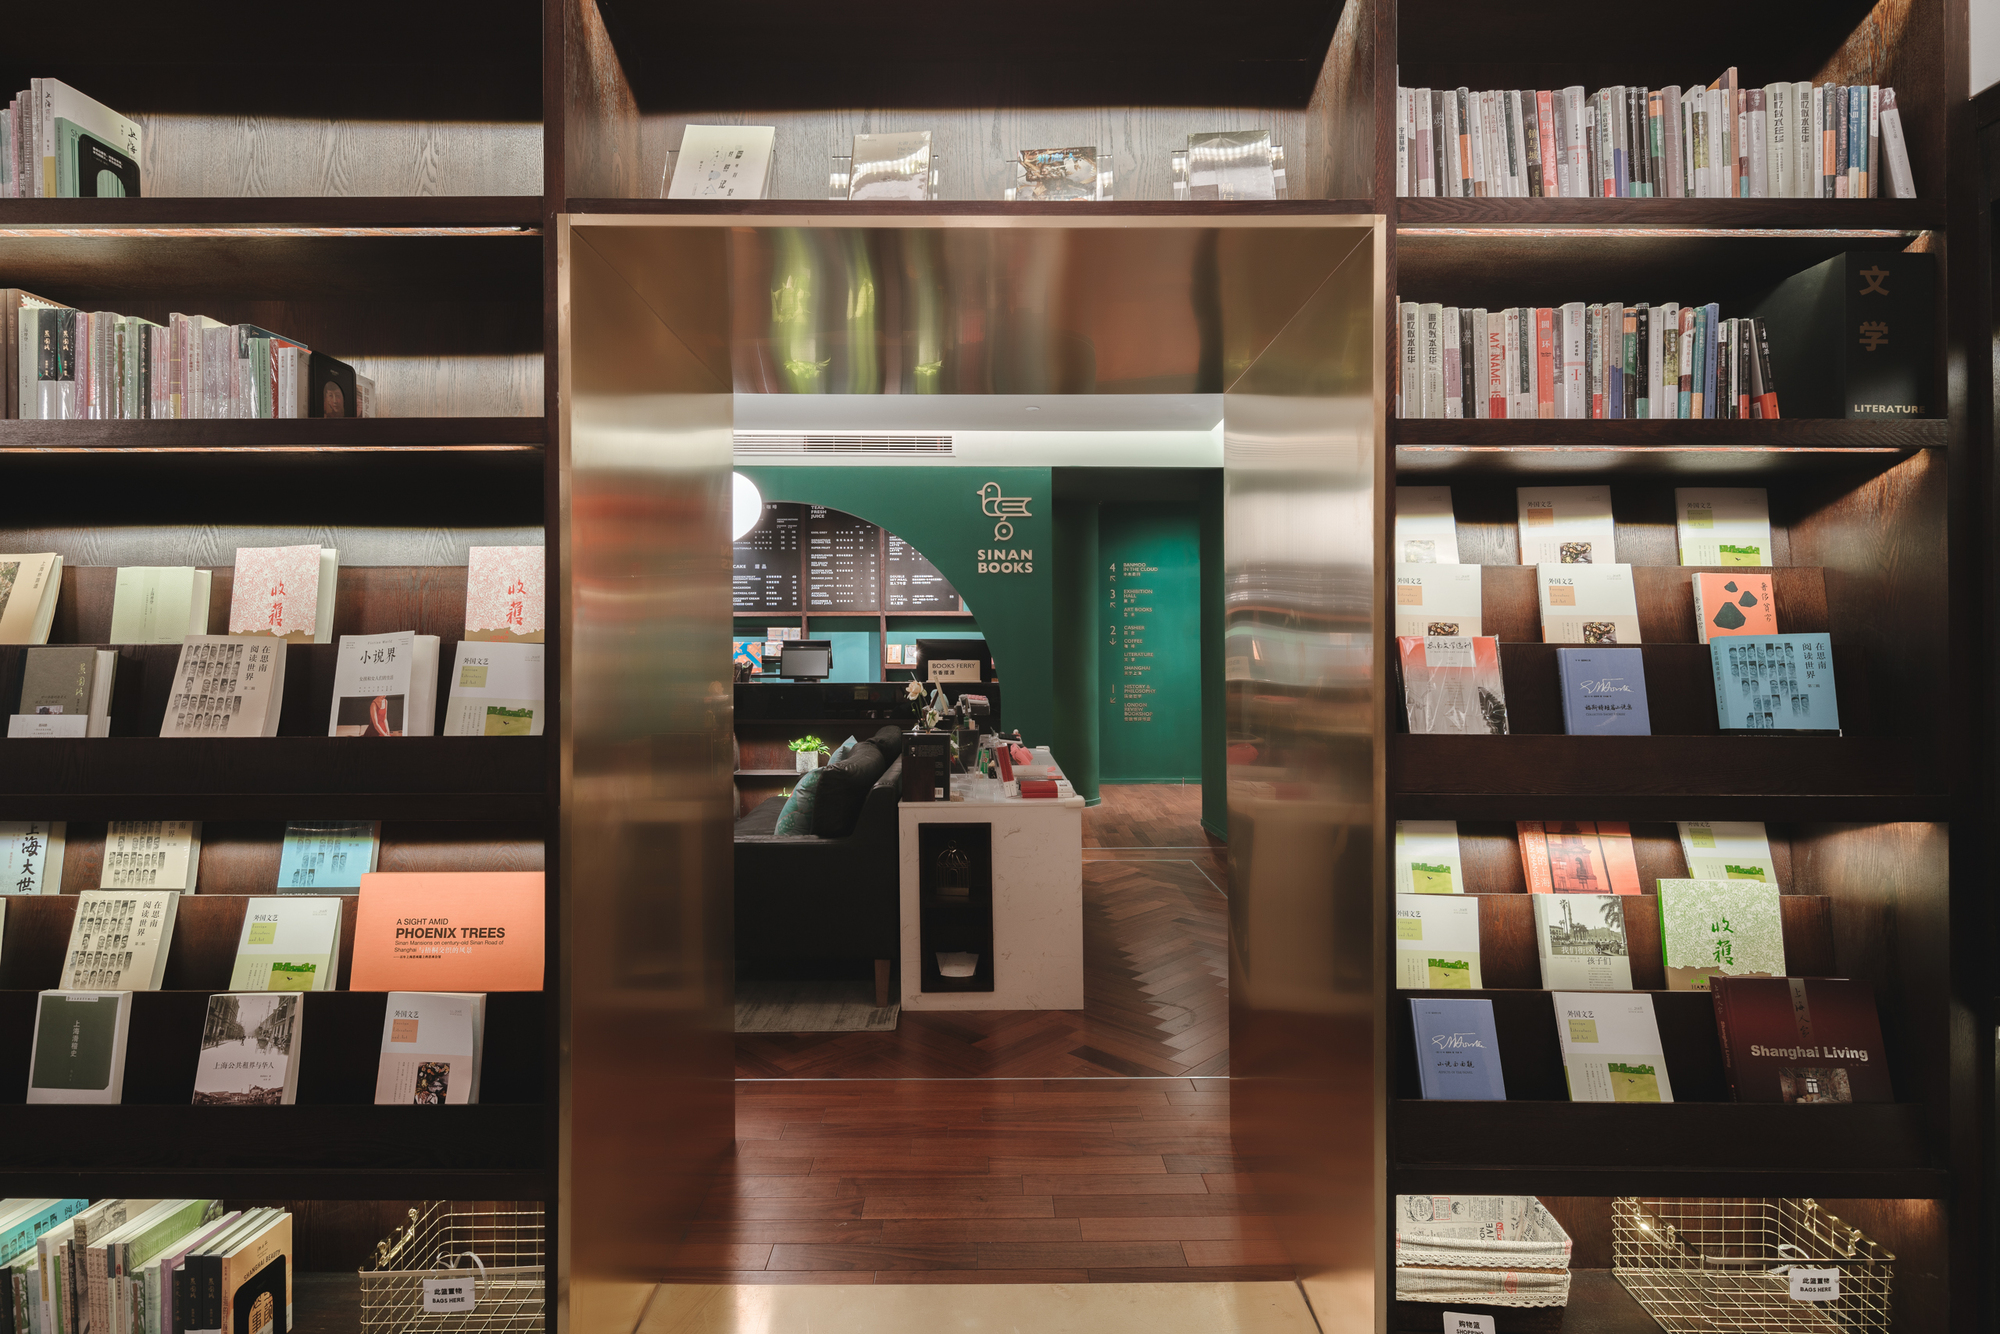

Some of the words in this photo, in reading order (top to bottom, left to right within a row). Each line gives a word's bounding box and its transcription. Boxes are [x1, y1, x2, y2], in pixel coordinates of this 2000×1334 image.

[1490, 332, 1500, 349] MY
[1491, 354, 1501, 385] NAME
[1854, 404, 1926, 414] LITERATURE
[977, 549, 1033, 561] SINAN
[977, 562, 1033, 574] BOOKS
[1109, 563, 1116, 572] 4
[1397, 577, 1422, 585] 外国文艺
[1548, 577, 1574, 585] 外国文艺
[1110, 589, 1116, 599] 3
[1109, 625, 1116, 635] 2
[258, 645, 271, 673] 在思南
[360, 647, 396, 664] 小说界
[1802, 642, 1816, 679] 阅读世界
[1815, 642, 1827, 670] 在思南
[245, 645, 260, 681] 阅读世界
[16, 824, 42, 895] 上海大世
[137, 900, 152, 937] 阅读世界
[149, 900, 162, 928] 在思南
[253, 914, 279, 922] 外国文艺
[396, 928, 457, 939] PHOENIX
[461, 928, 506, 939] TREES
[1587, 956, 1612, 965] 孩子们
[394, 1010, 419, 1019] 外国文艺
[1567, 1010, 1595, 1018] 外国文艺
[1794, 987, 1810, 1038] 上海人家
[1750, 1045, 1820, 1060] Shanghai
[1824, 1047, 1868, 1061] Living
[213, 1061, 275, 1070] 上海公共租界与华人
[243, 1260, 265, 1282] SHANGHAI
[1458, 1320, 1480, 1329] 购物篮
